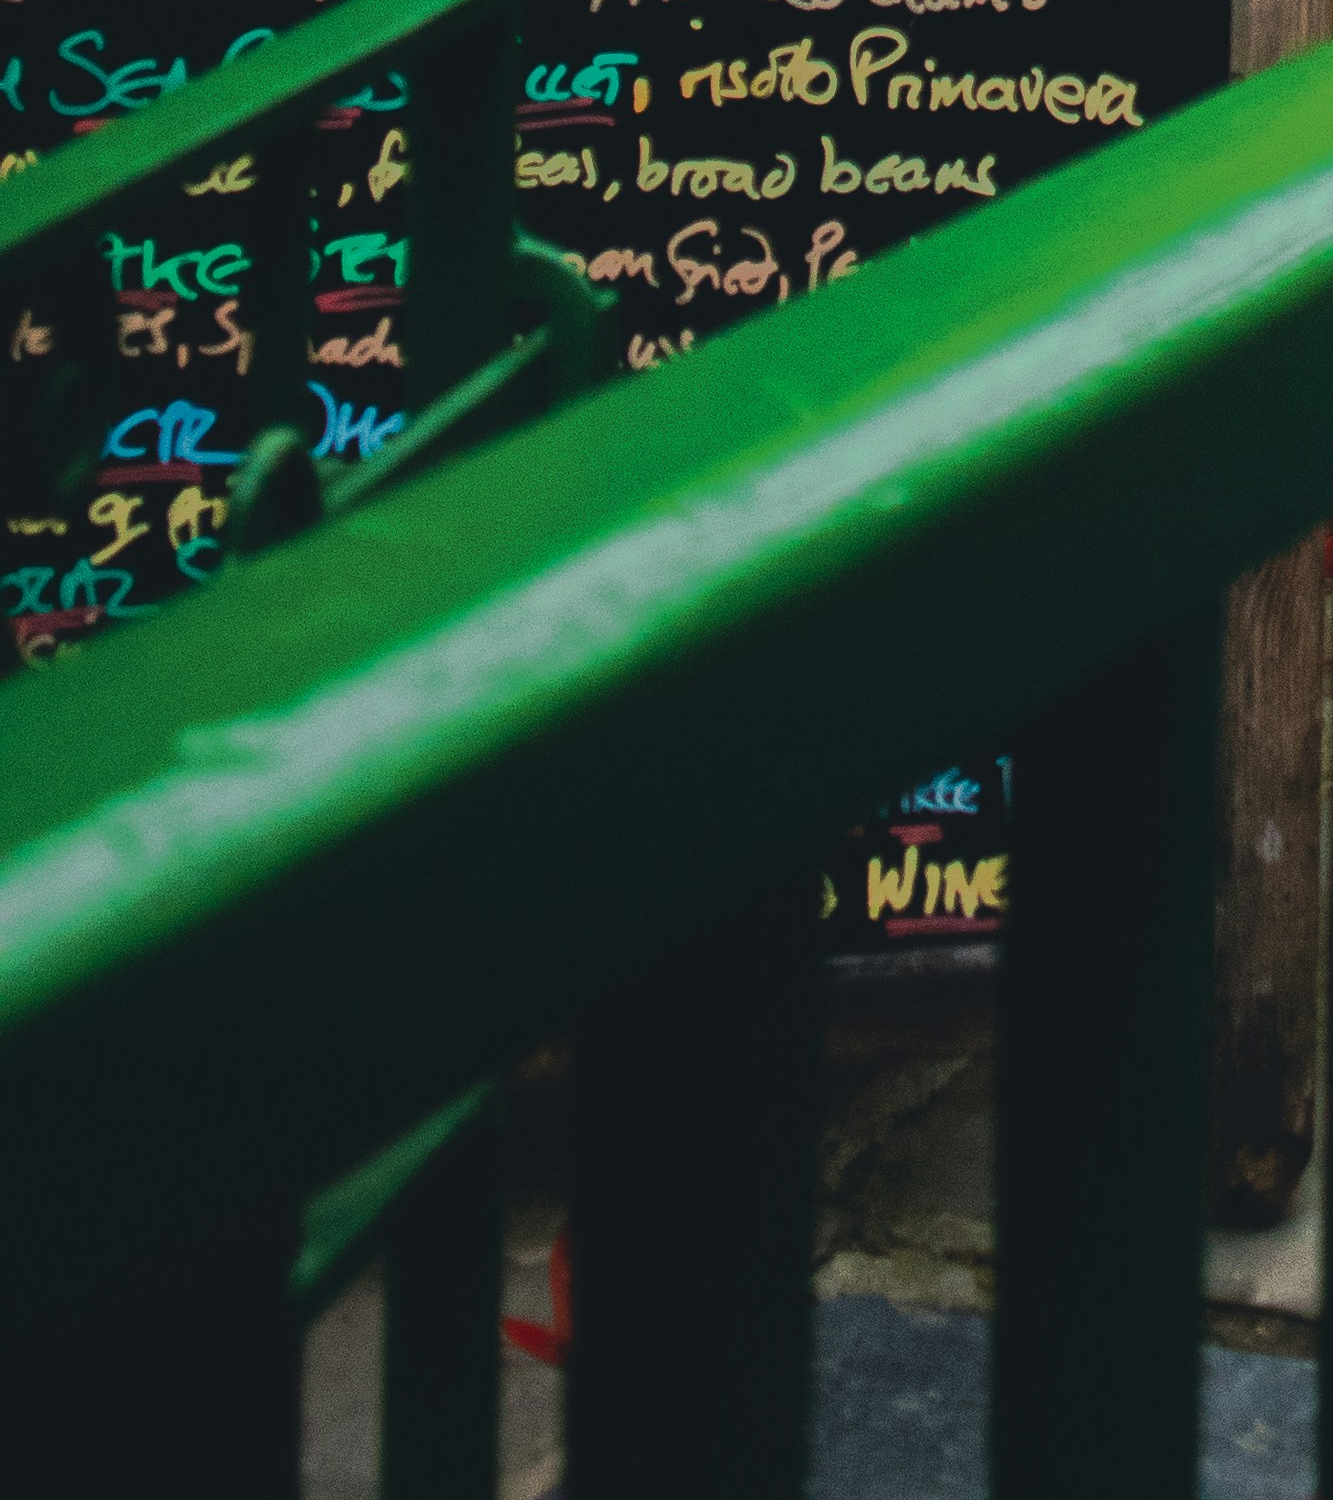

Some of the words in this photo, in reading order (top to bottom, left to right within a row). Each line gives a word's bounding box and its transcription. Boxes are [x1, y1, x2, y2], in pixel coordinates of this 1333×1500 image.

[848, 26, 1144, 125] Primavera
[636, 134, 797, 200] broad
[820, 134, 997, 197] beans
